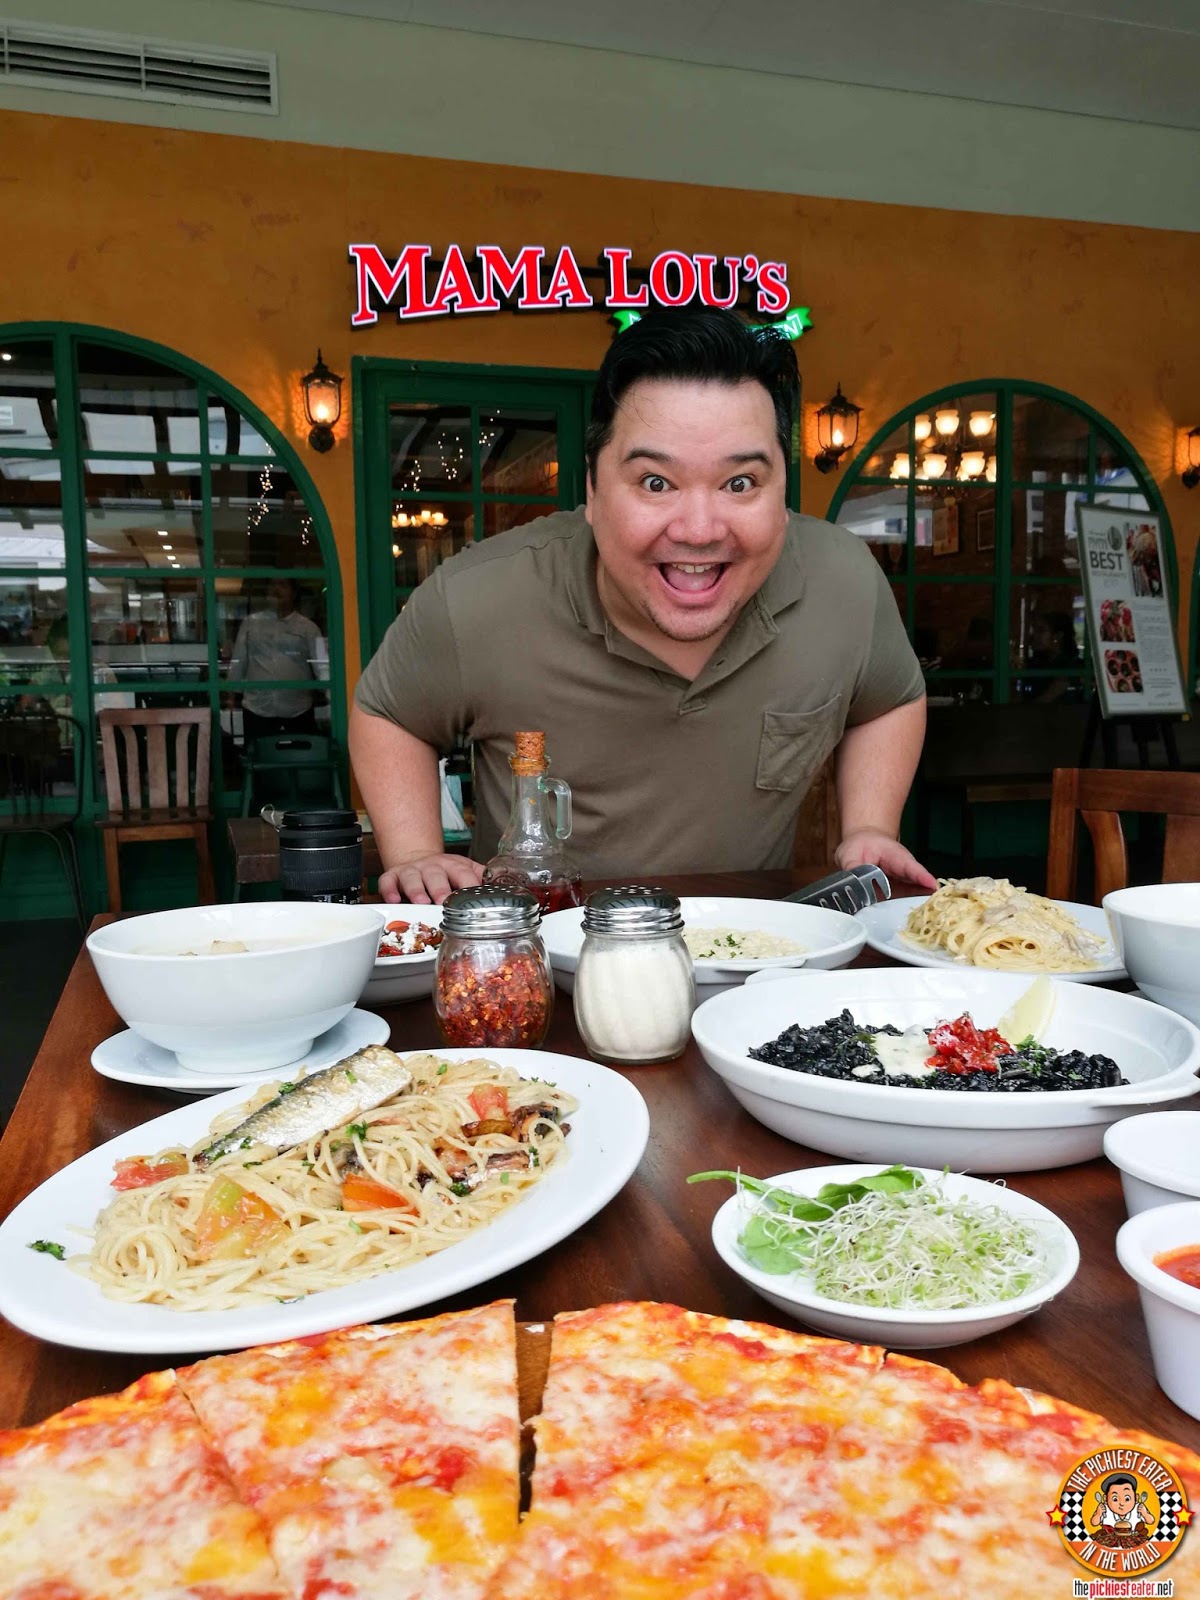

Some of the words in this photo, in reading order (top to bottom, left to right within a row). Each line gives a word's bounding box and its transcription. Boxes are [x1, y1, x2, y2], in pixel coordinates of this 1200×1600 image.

[349, 244, 593, 327] MAMA
[604, 247, 790, 314] LOU'S
[1089, 551, 1124, 571] BEST
